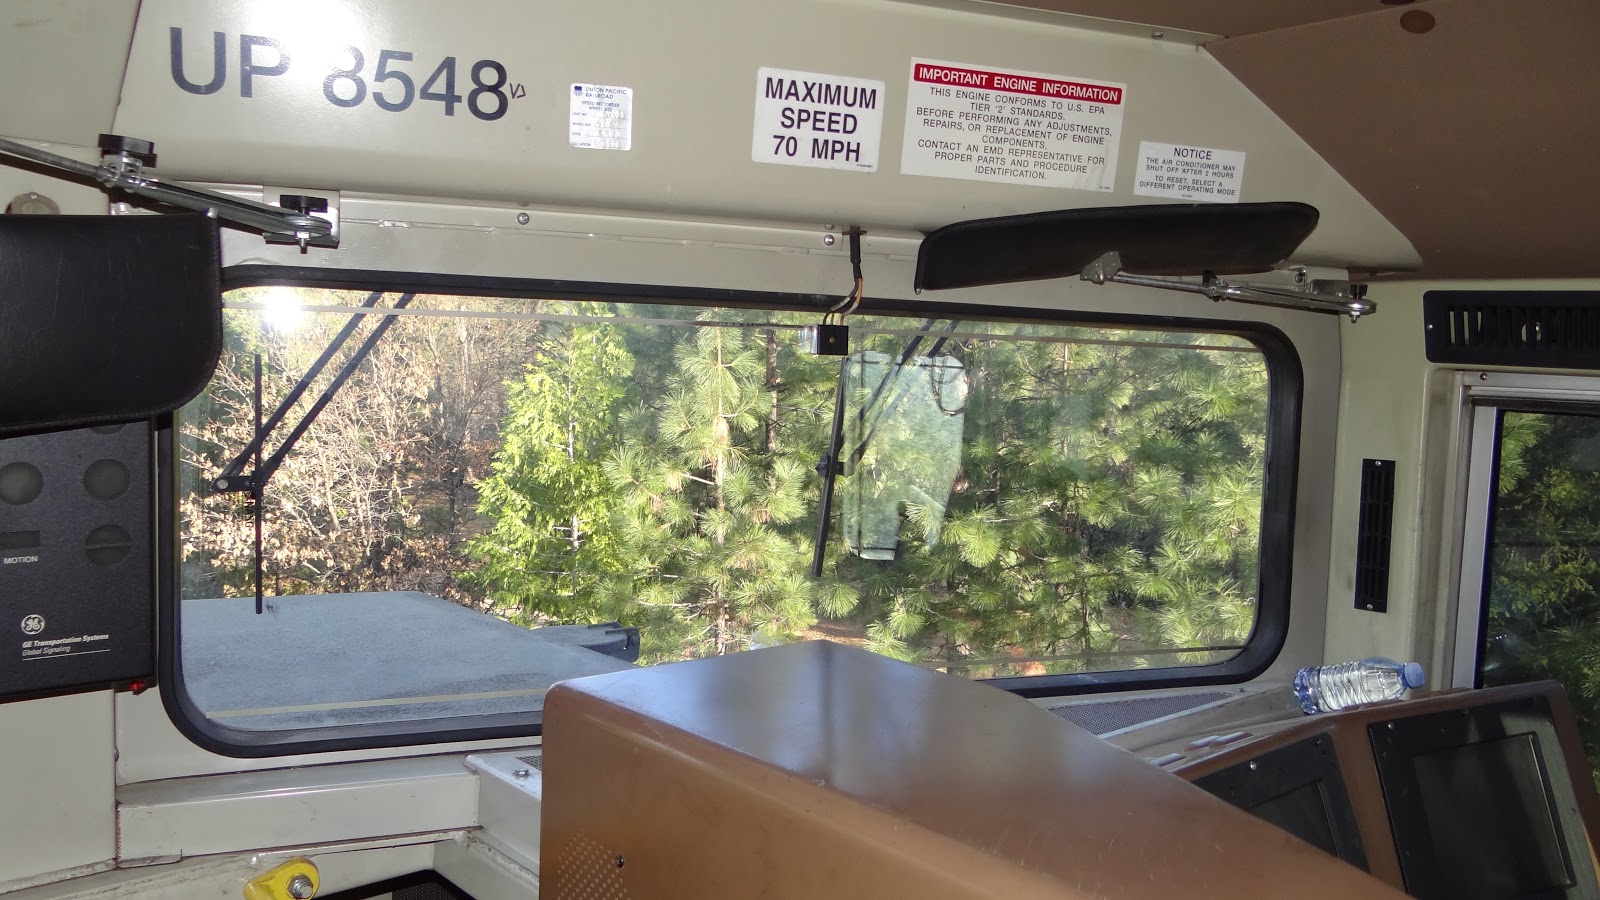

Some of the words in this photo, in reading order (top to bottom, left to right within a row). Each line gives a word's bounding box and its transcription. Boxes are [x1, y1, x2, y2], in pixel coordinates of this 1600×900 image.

[170, 26, 291, 98] UP
[323, 45, 508, 121] 8548
[919, 68, 988, 86] IMPORTANT
[994, 77, 1037, 92] ENGINE
[1042, 82, 1118, 101] INFORMATION
[765, 77, 876, 110] MAXIMUM
[930, 87, 950, 97] THIS
[956, 90, 990, 101] ENGINE
[995, 95, 1046, 108] CONFORMS
[1051, 101, 1062, 110] TO
[1068, 103, 1083, 112] U.S.
[1089, 106, 1104, 114] EPA
[780, 107, 858, 134] SPEED
[916, 107, 954, 118] BEFORE
[959, 112, 1019, 125] PERFORMING
[1024, 119, 1042, 128] ANY
[1047, 122, 1112, 136] ADJUSTMENTS,
[970, 102, 990, 112] TIER
[1010, 107, 1065, 120] STANDARDS.
[923, 119, 964, 131] REPAIRS,
[968, 123, 981, 132] OR
[986, 125, 1052, 139] REPLACEMENT
[1056, 132, 1068, 141] OF
[1072, 134, 1104, 145] ENGINE
[773, 135, 798, 157] 70
[812, 138, 860, 162] MPH
[918, 139, 961, 151] CONTACT
[966, 144, 978, 152] AN
[984, 146, 1003, 155] EMD
[1008, 148, 1083, 163] REPRESENTATIVE
[1087, 156, 1105, 165] FOR
[1174, 148, 1212, 160] NOTICE
[934, 152, 972, 162] PROPER
[977, 156, 1006, 166] PARTS
[1010, 159, 1029, 168] AND
[1034, 161, 1087, 173] PROCEDURE
[975, 166, 1046, 180] IDENTIFICATION.
[1176, 160, 1219, 170] CONDITIONER
[1140, 181, 1175, 190] DIFFERENT
[1178, 185, 1214, 194] OPERATING
[4, 556, 38, 564] MOTION
[34, 636, 81, 646] Transportation
[43, 646, 71, 654] Signaling
